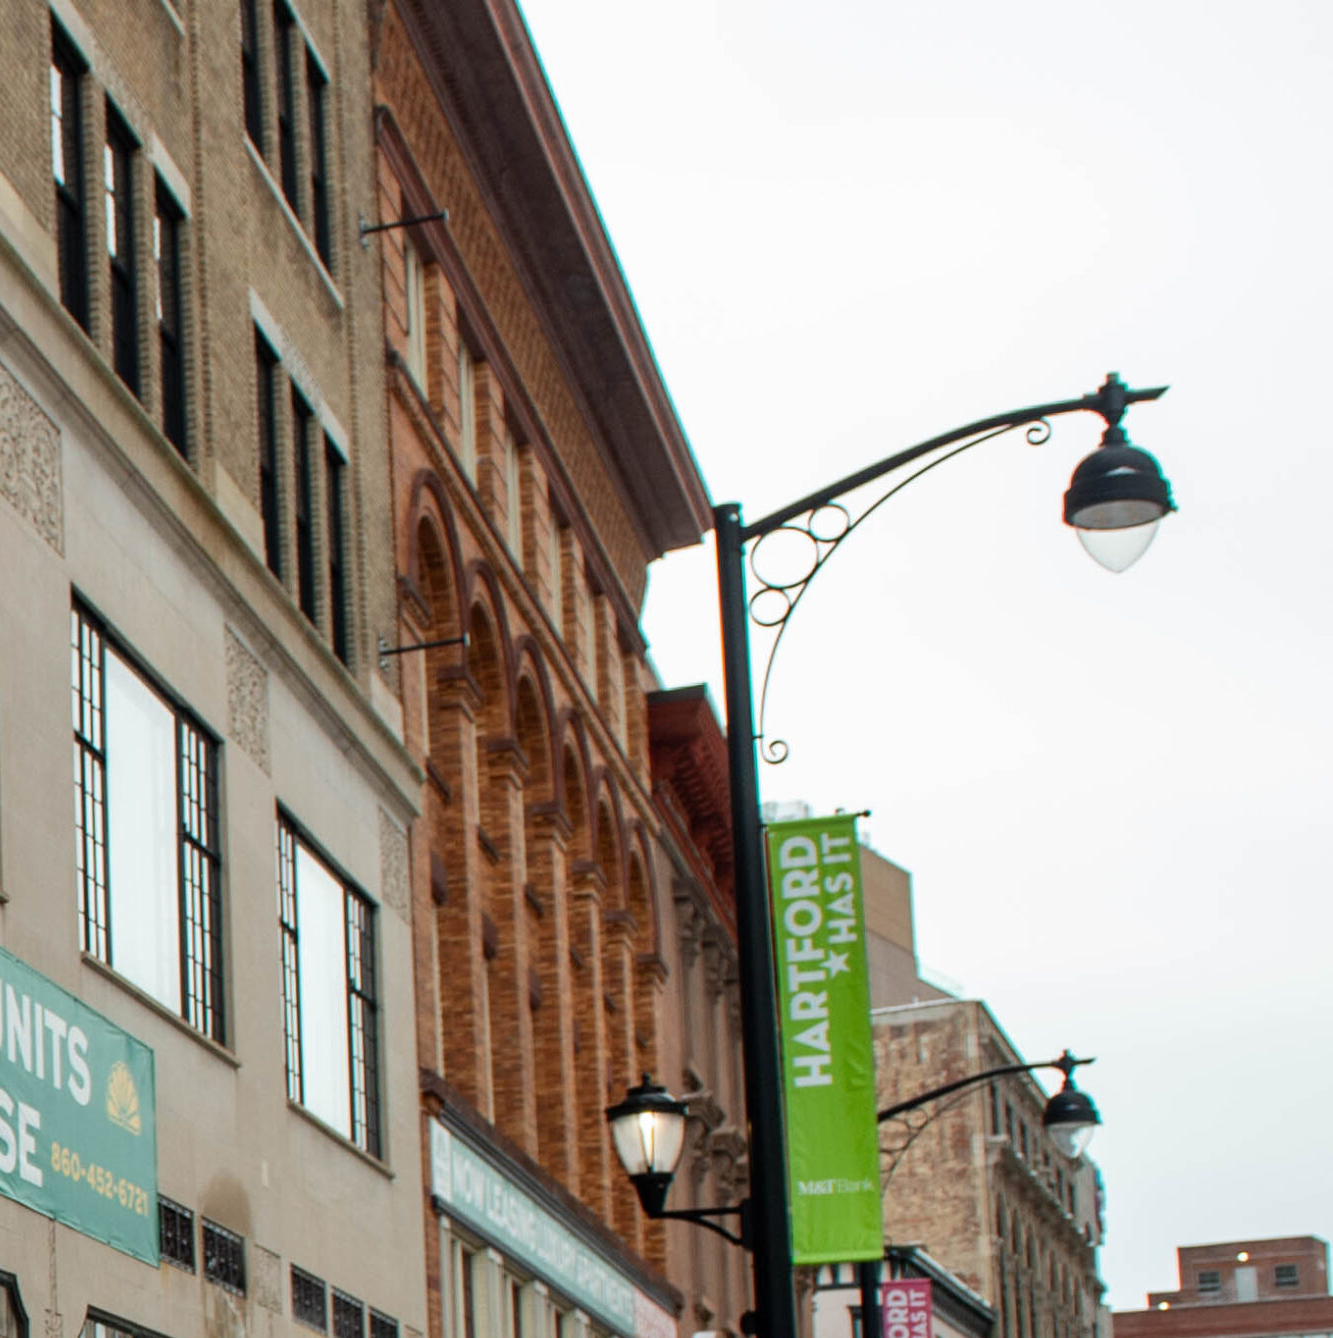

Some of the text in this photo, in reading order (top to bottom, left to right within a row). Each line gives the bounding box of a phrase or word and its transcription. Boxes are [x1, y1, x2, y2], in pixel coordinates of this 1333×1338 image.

[821, 832, 857, 944] HAS IT
[780, 835, 833, 1088] HARTFORD
[50, 1141, 149, 1218] 860-452-6721
[797, 1178, 874, 1196] M&T Bank
[909, 1289, 926, 1306] IT
